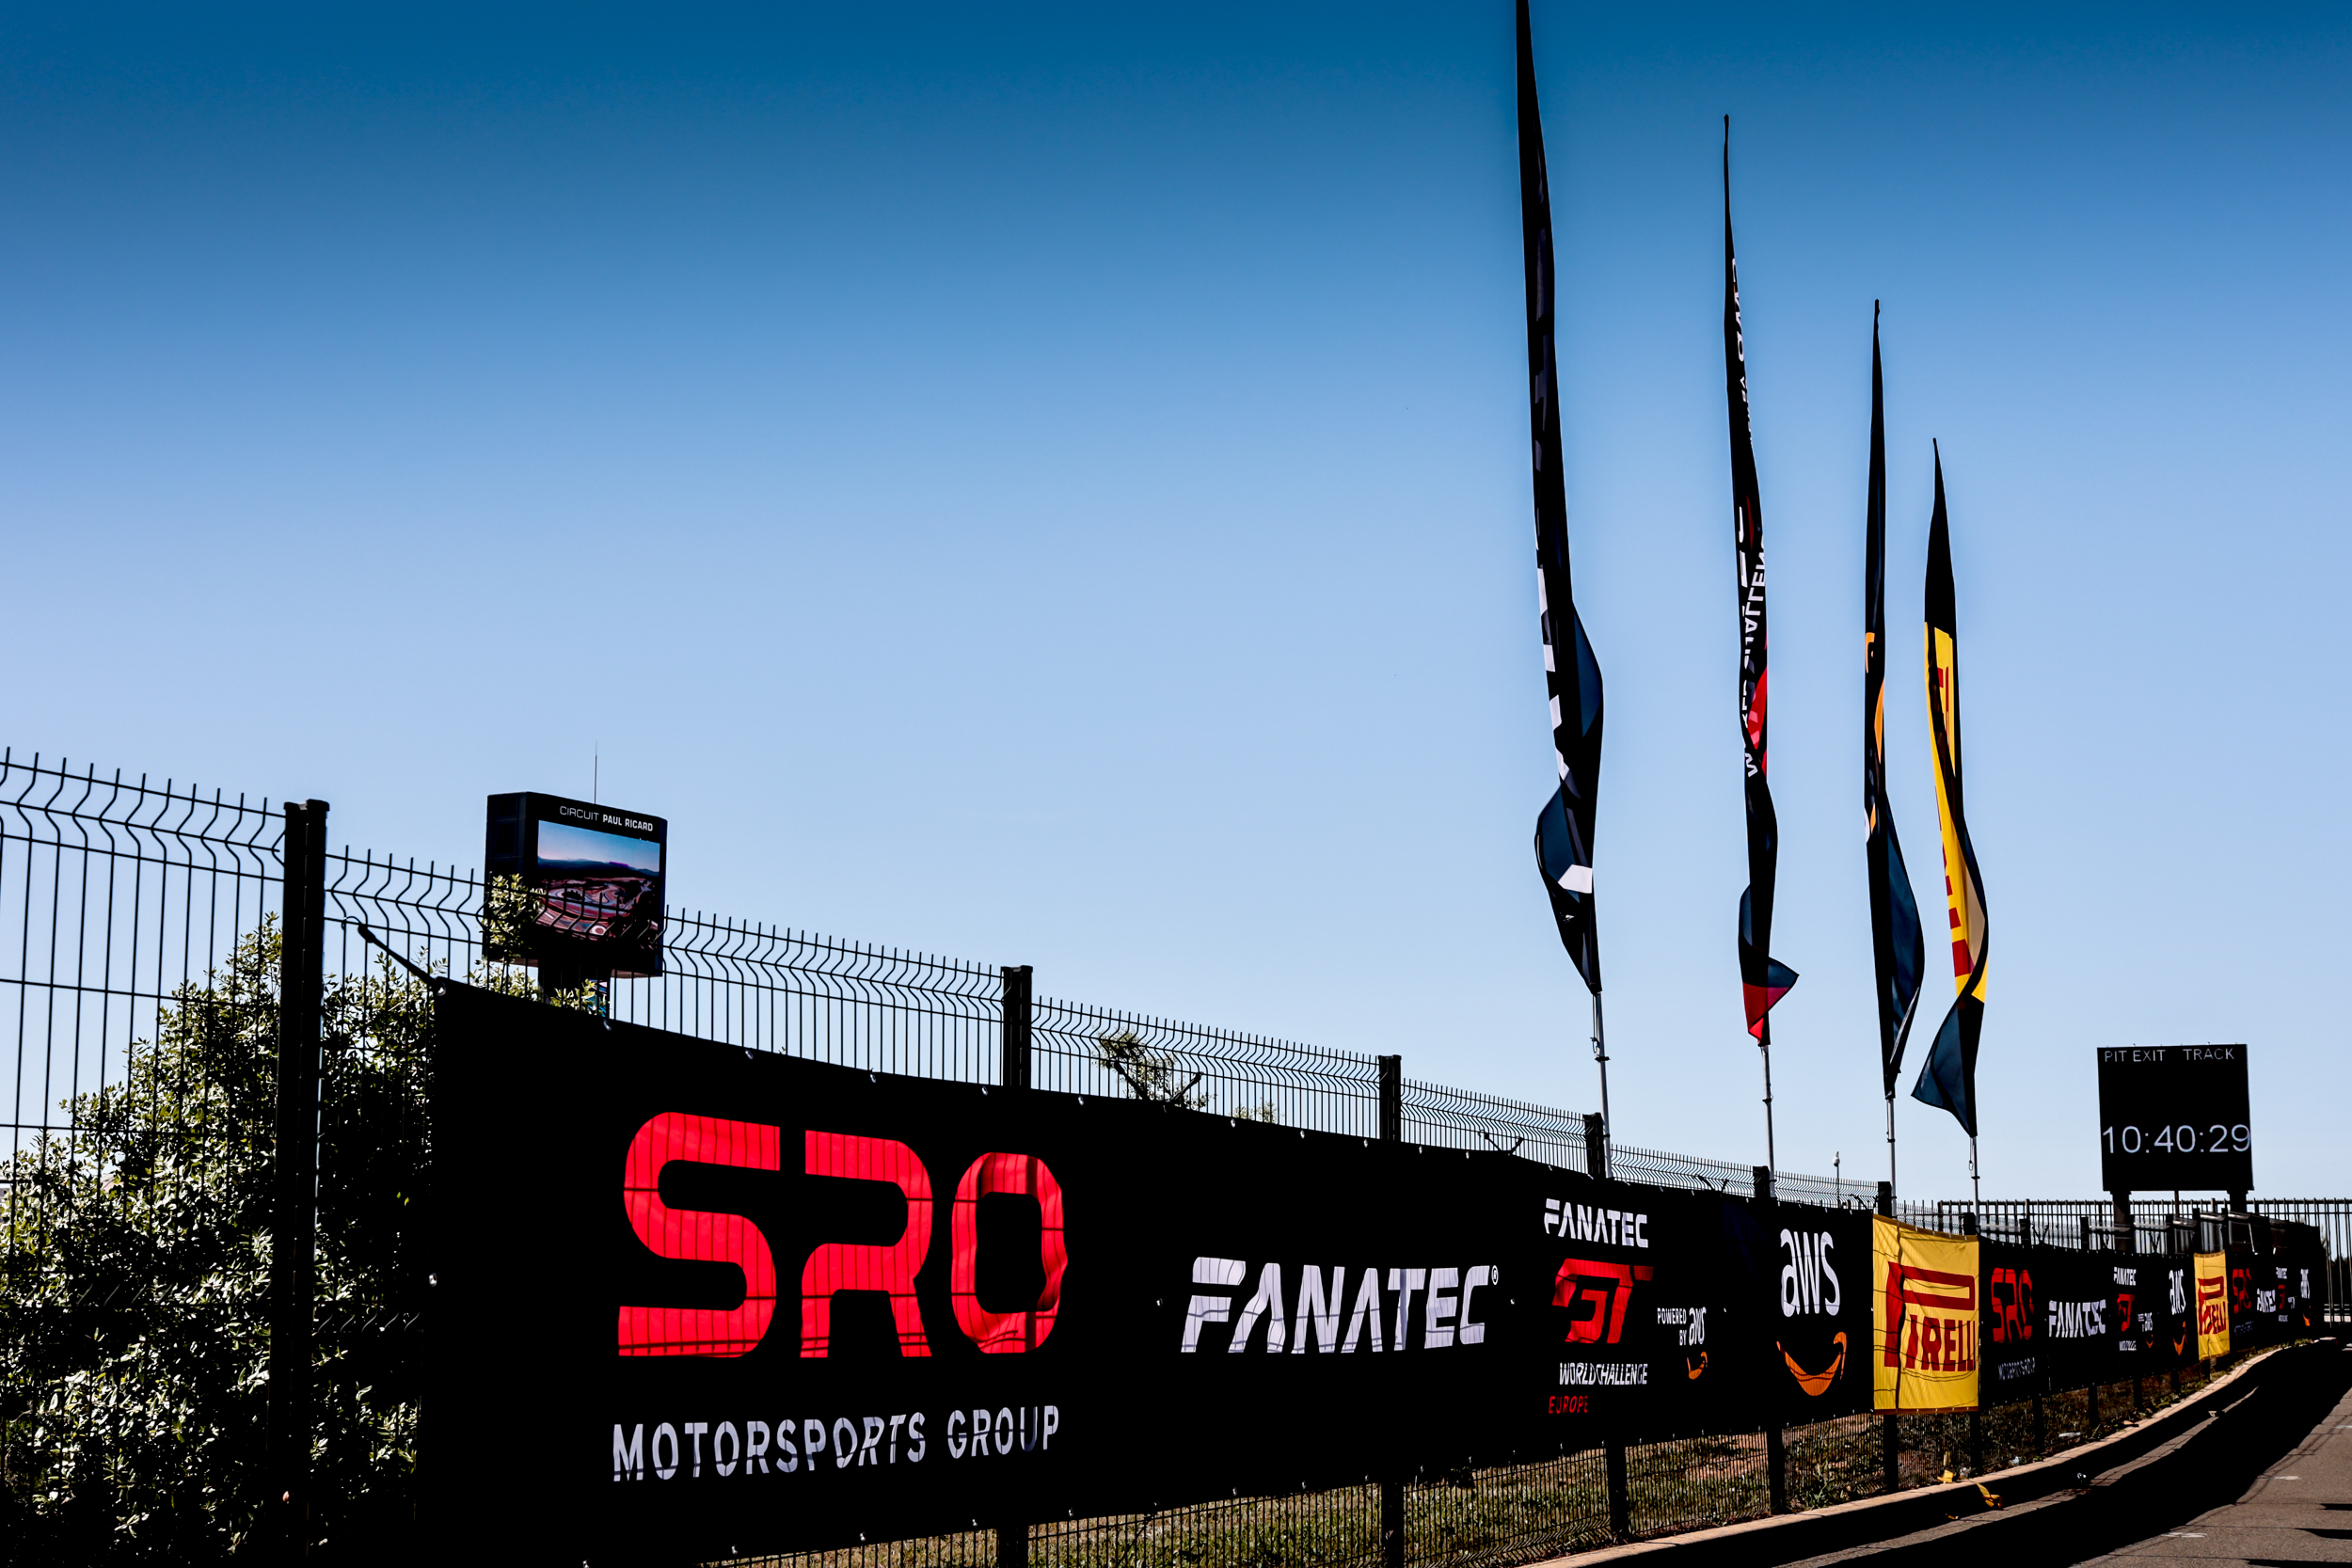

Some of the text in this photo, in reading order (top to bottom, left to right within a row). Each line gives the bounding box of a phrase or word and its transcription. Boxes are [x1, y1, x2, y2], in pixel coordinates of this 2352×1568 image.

[560, 805, 653, 832] CIRCUIT PAUL RICARD
[2105, 1048, 2234, 1062] PIT EXIT TRACK
[2103, 1124, 2250, 1153] 10:40:29
[618, 1112, 1068, 1358] SRO
[1544, 1198, 1648, 1248] FANATEC
[1780, 1228, 1840, 1318] aws
[1657, 1307, 1687, 1324] POWERED
[1884, 1260, 1976, 1372] PIRELLI
[1679, 1329, 1687, 1346] BY
[1548, 1395, 1589, 1415] EUROPE
[613, 1405, 1059, 1481] MOTORSPORTS GROUP
